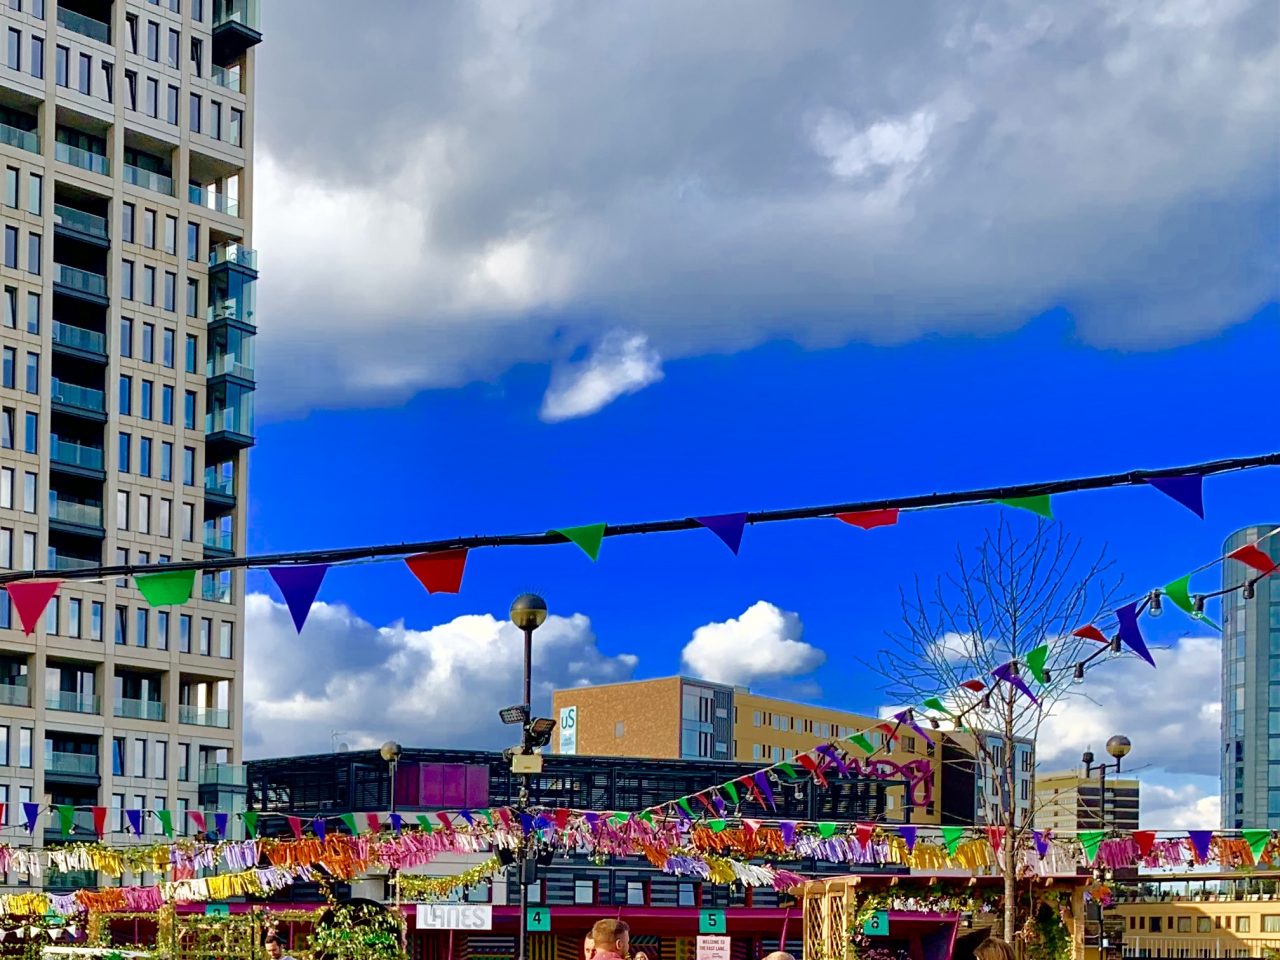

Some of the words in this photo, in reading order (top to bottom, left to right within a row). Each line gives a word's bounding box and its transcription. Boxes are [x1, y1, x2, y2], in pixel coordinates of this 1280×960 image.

[423, 906, 486, 928] LANES
[532, 911, 542, 925] 4
[708, 913, 717, 927] 5
